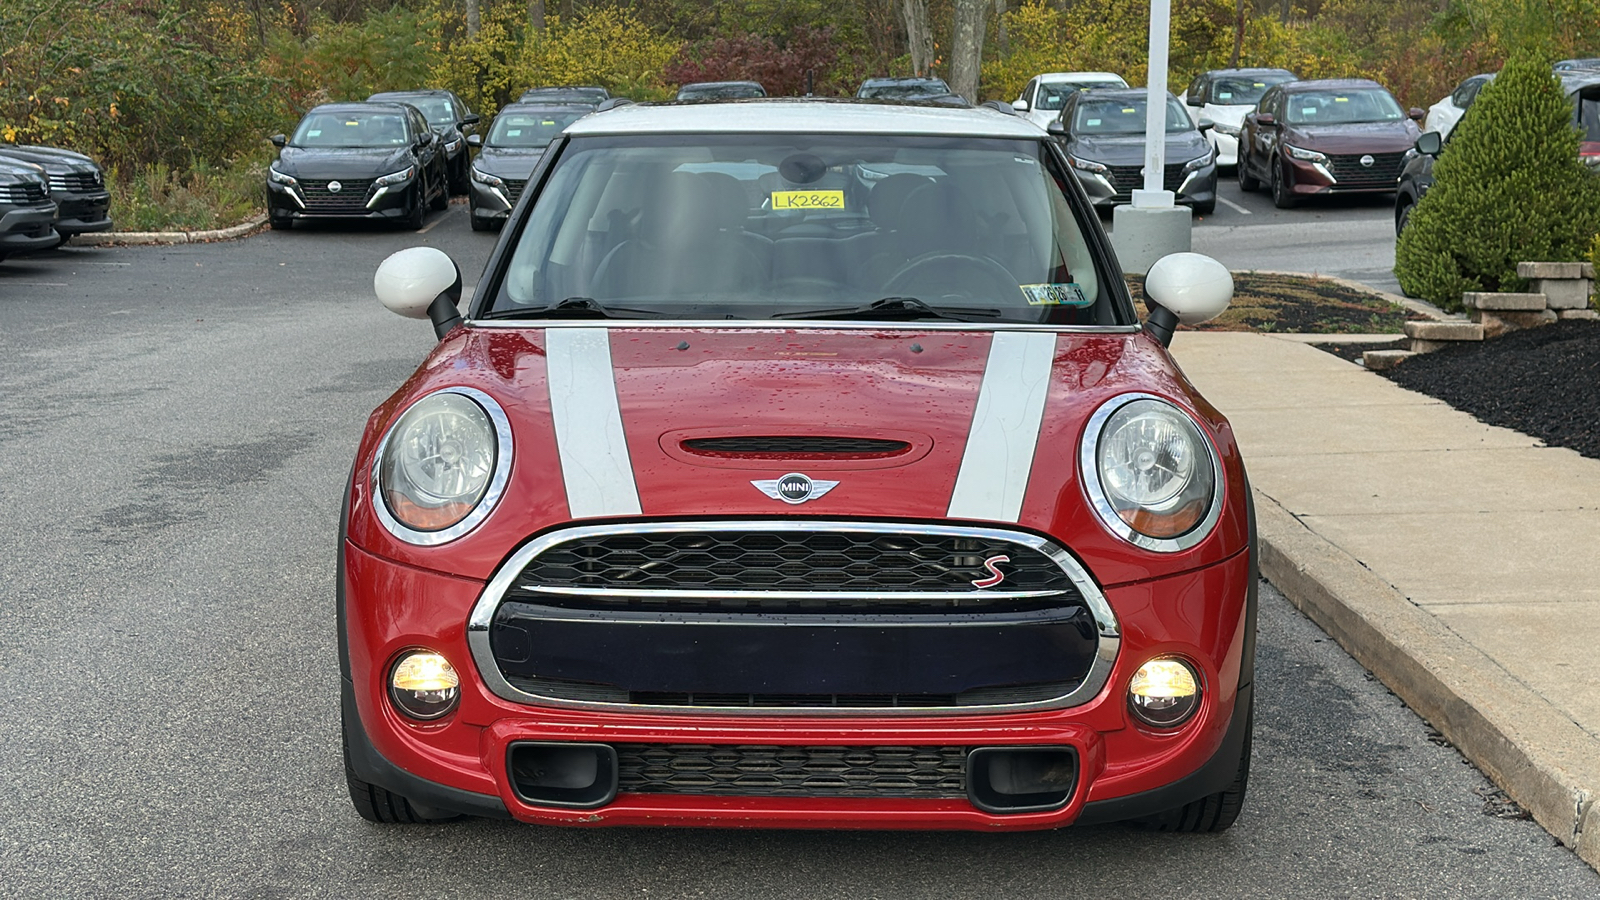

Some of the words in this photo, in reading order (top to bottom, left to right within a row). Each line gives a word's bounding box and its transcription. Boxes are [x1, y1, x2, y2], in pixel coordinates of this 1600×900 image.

[774, 194, 840, 208] LK2862
[781, 482, 809, 492] MINI
[971, 555, 1010, 588] S
